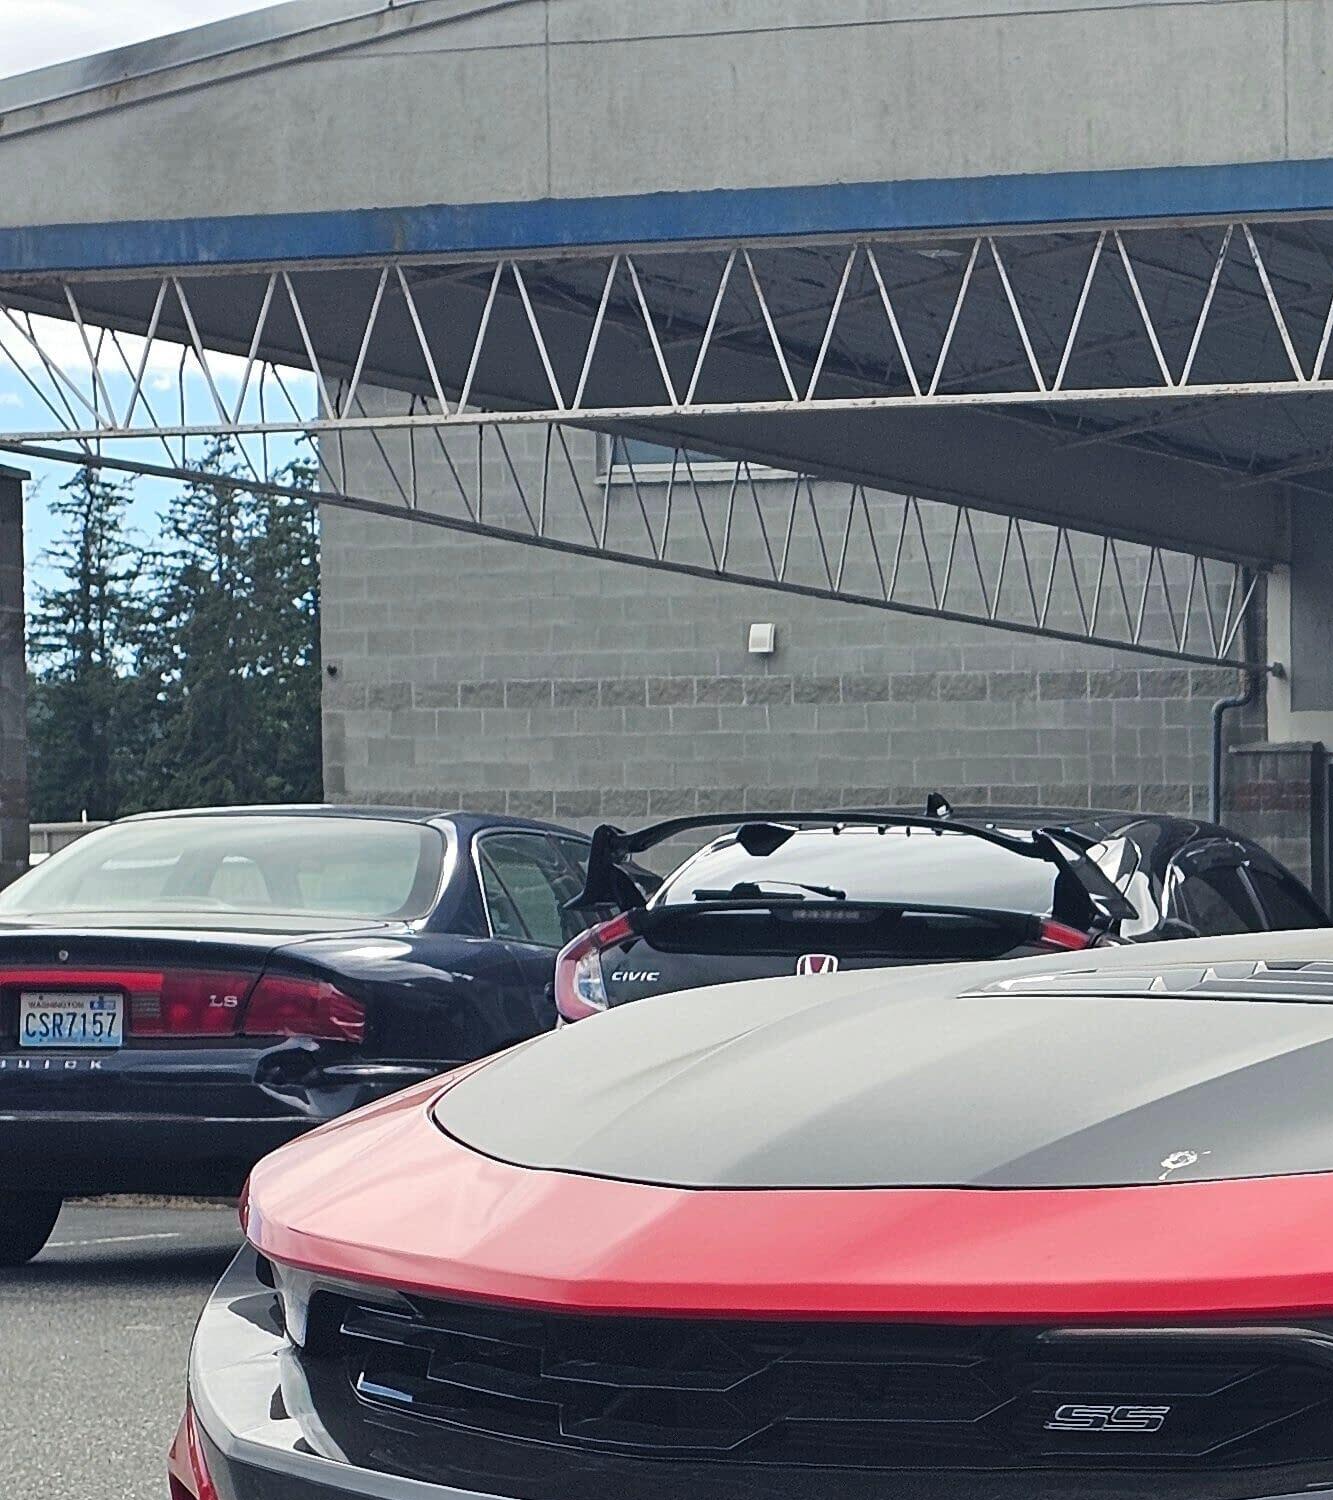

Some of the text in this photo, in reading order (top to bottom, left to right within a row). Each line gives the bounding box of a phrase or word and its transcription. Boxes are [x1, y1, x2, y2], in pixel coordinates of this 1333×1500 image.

[611, 972, 660, 982] CIVIC
[209, 995, 238, 1008] LS
[25, 1013, 116, 1038] CSR7157
[1043, 1404, 1170, 1432] SS
